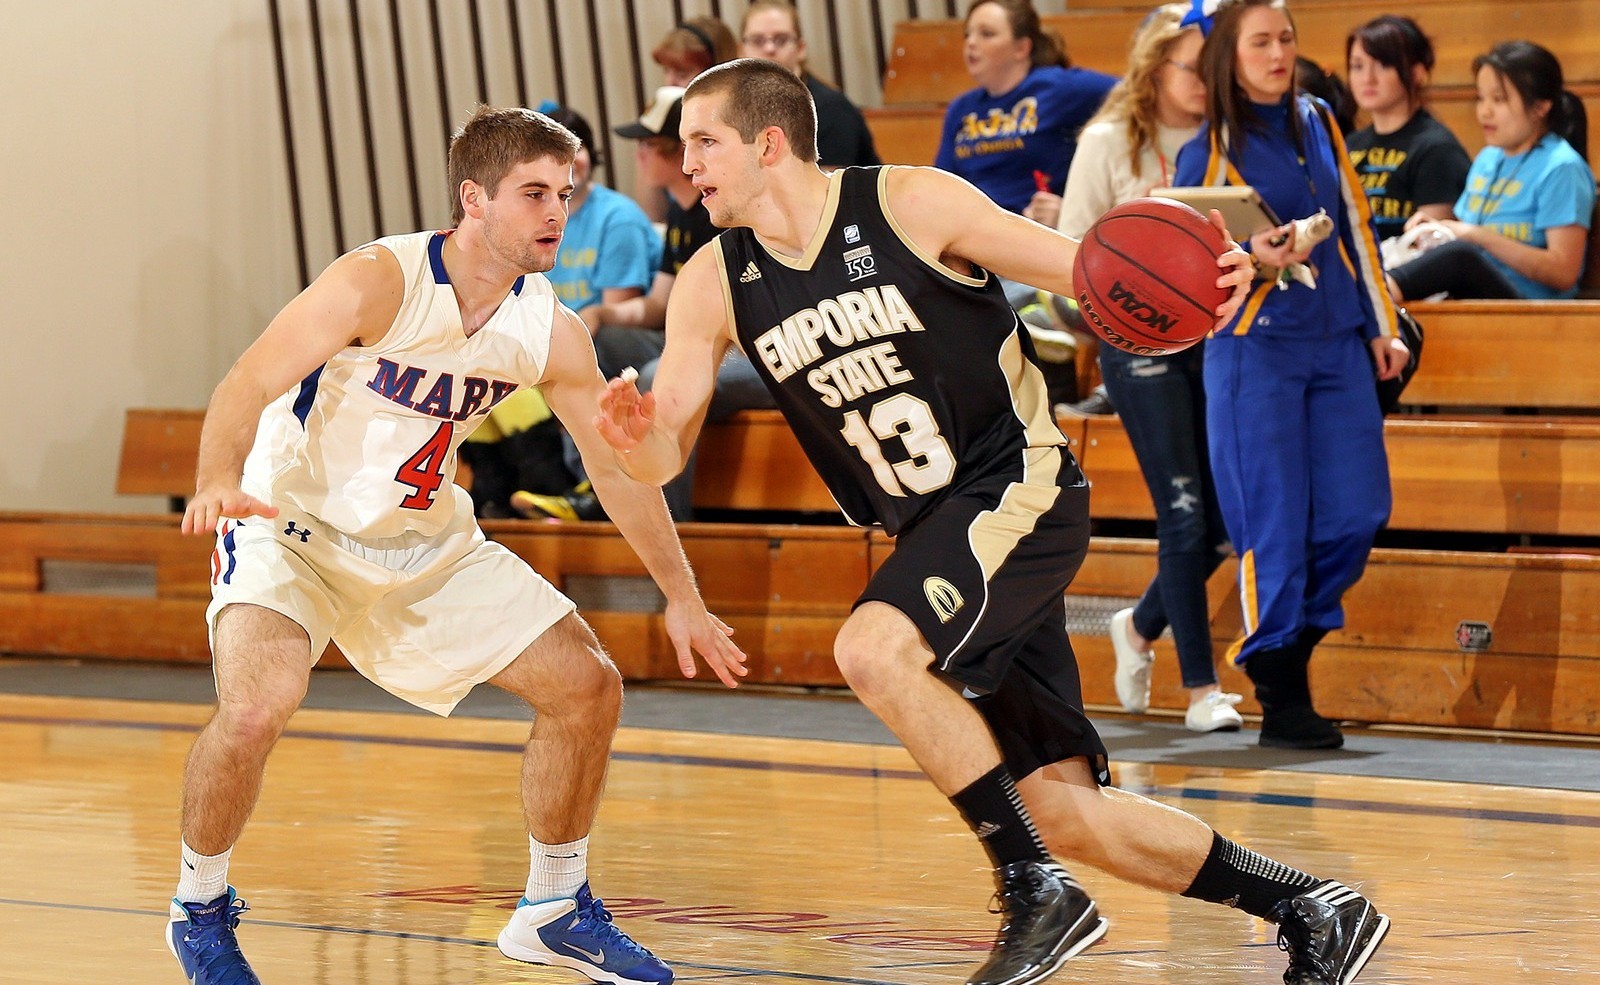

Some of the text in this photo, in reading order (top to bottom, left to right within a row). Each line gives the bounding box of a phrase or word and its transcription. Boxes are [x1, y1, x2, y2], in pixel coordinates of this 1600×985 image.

[845, 255, 875, 278] 150
[753, 284, 926, 384] EMPORIA
[1106, 281, 1180, 334] NCAA
[366, 357, 519, 422] MARY
[807, 341, 914, 409] STATE
[394, 421, 454, 511] 4
[839, 392, 957, 498] 13
